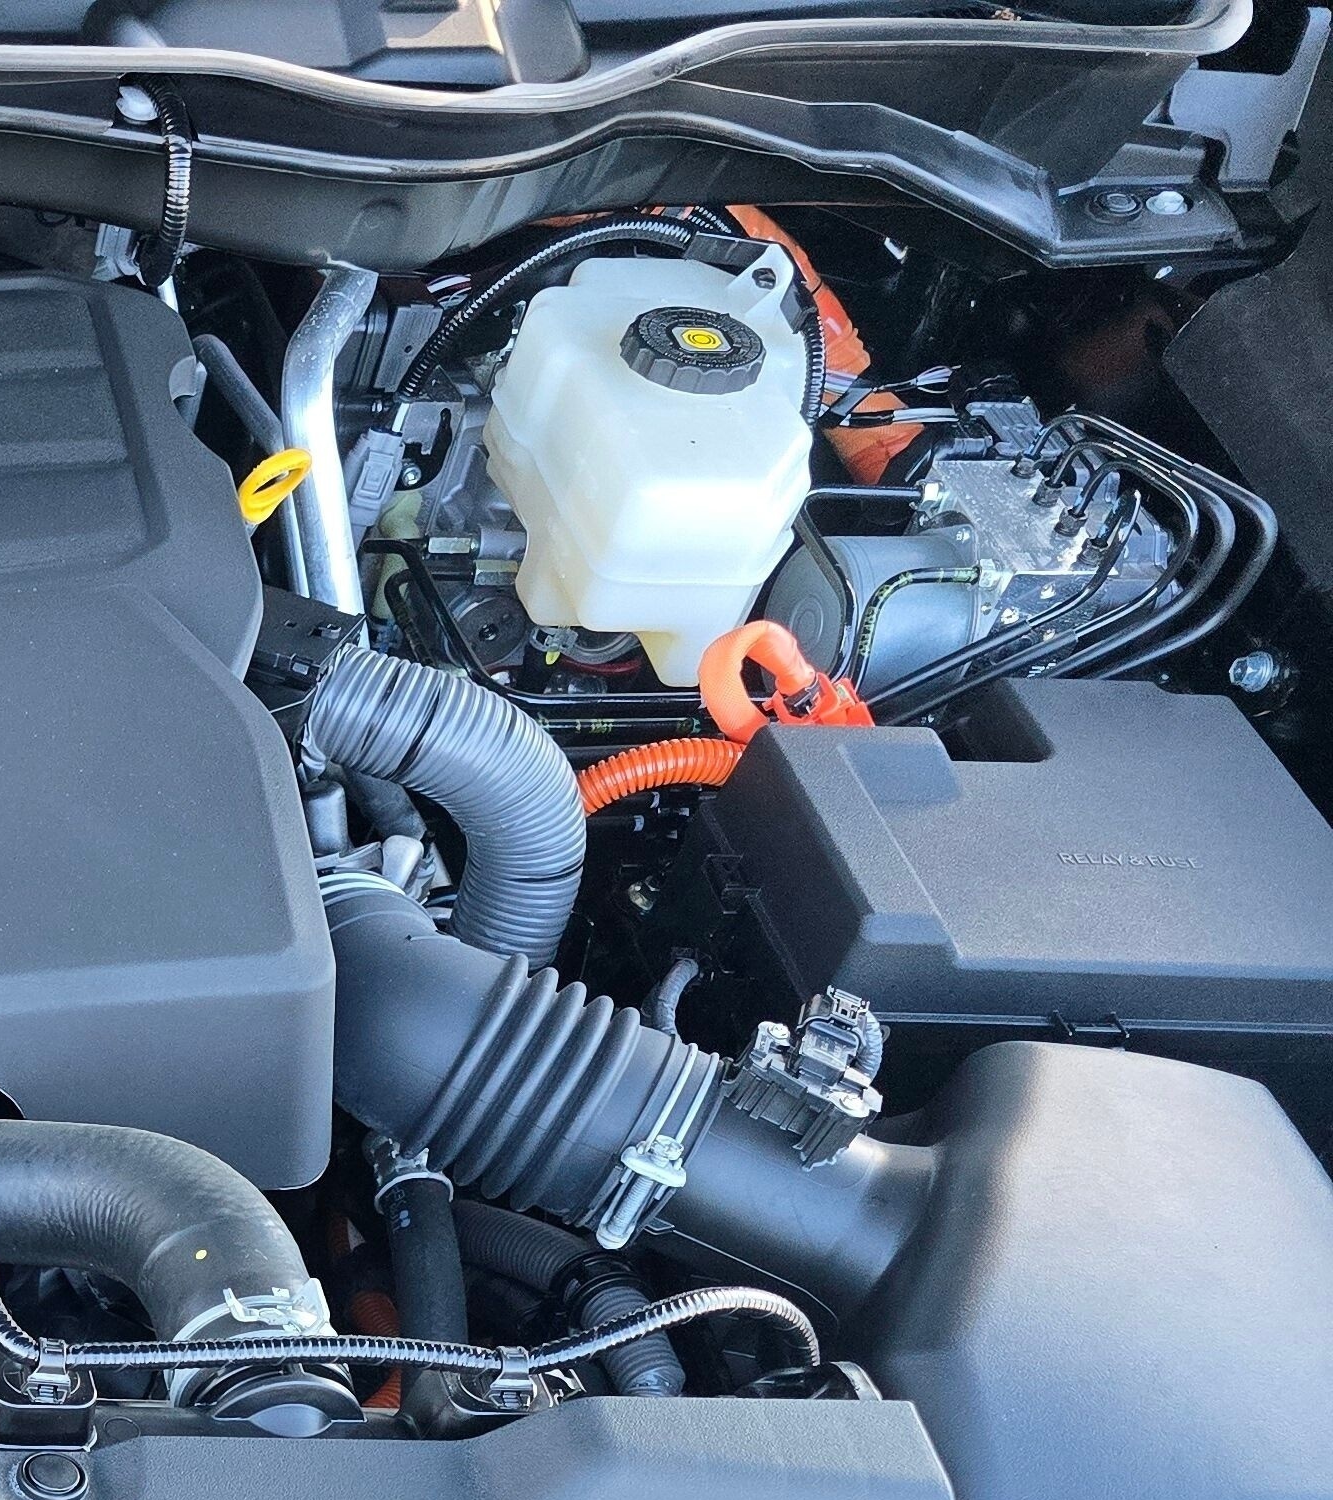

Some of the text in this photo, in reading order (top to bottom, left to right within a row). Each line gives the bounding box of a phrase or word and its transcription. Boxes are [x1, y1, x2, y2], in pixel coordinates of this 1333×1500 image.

[1057, 852, 1204, 870] RELAY & FUSE
